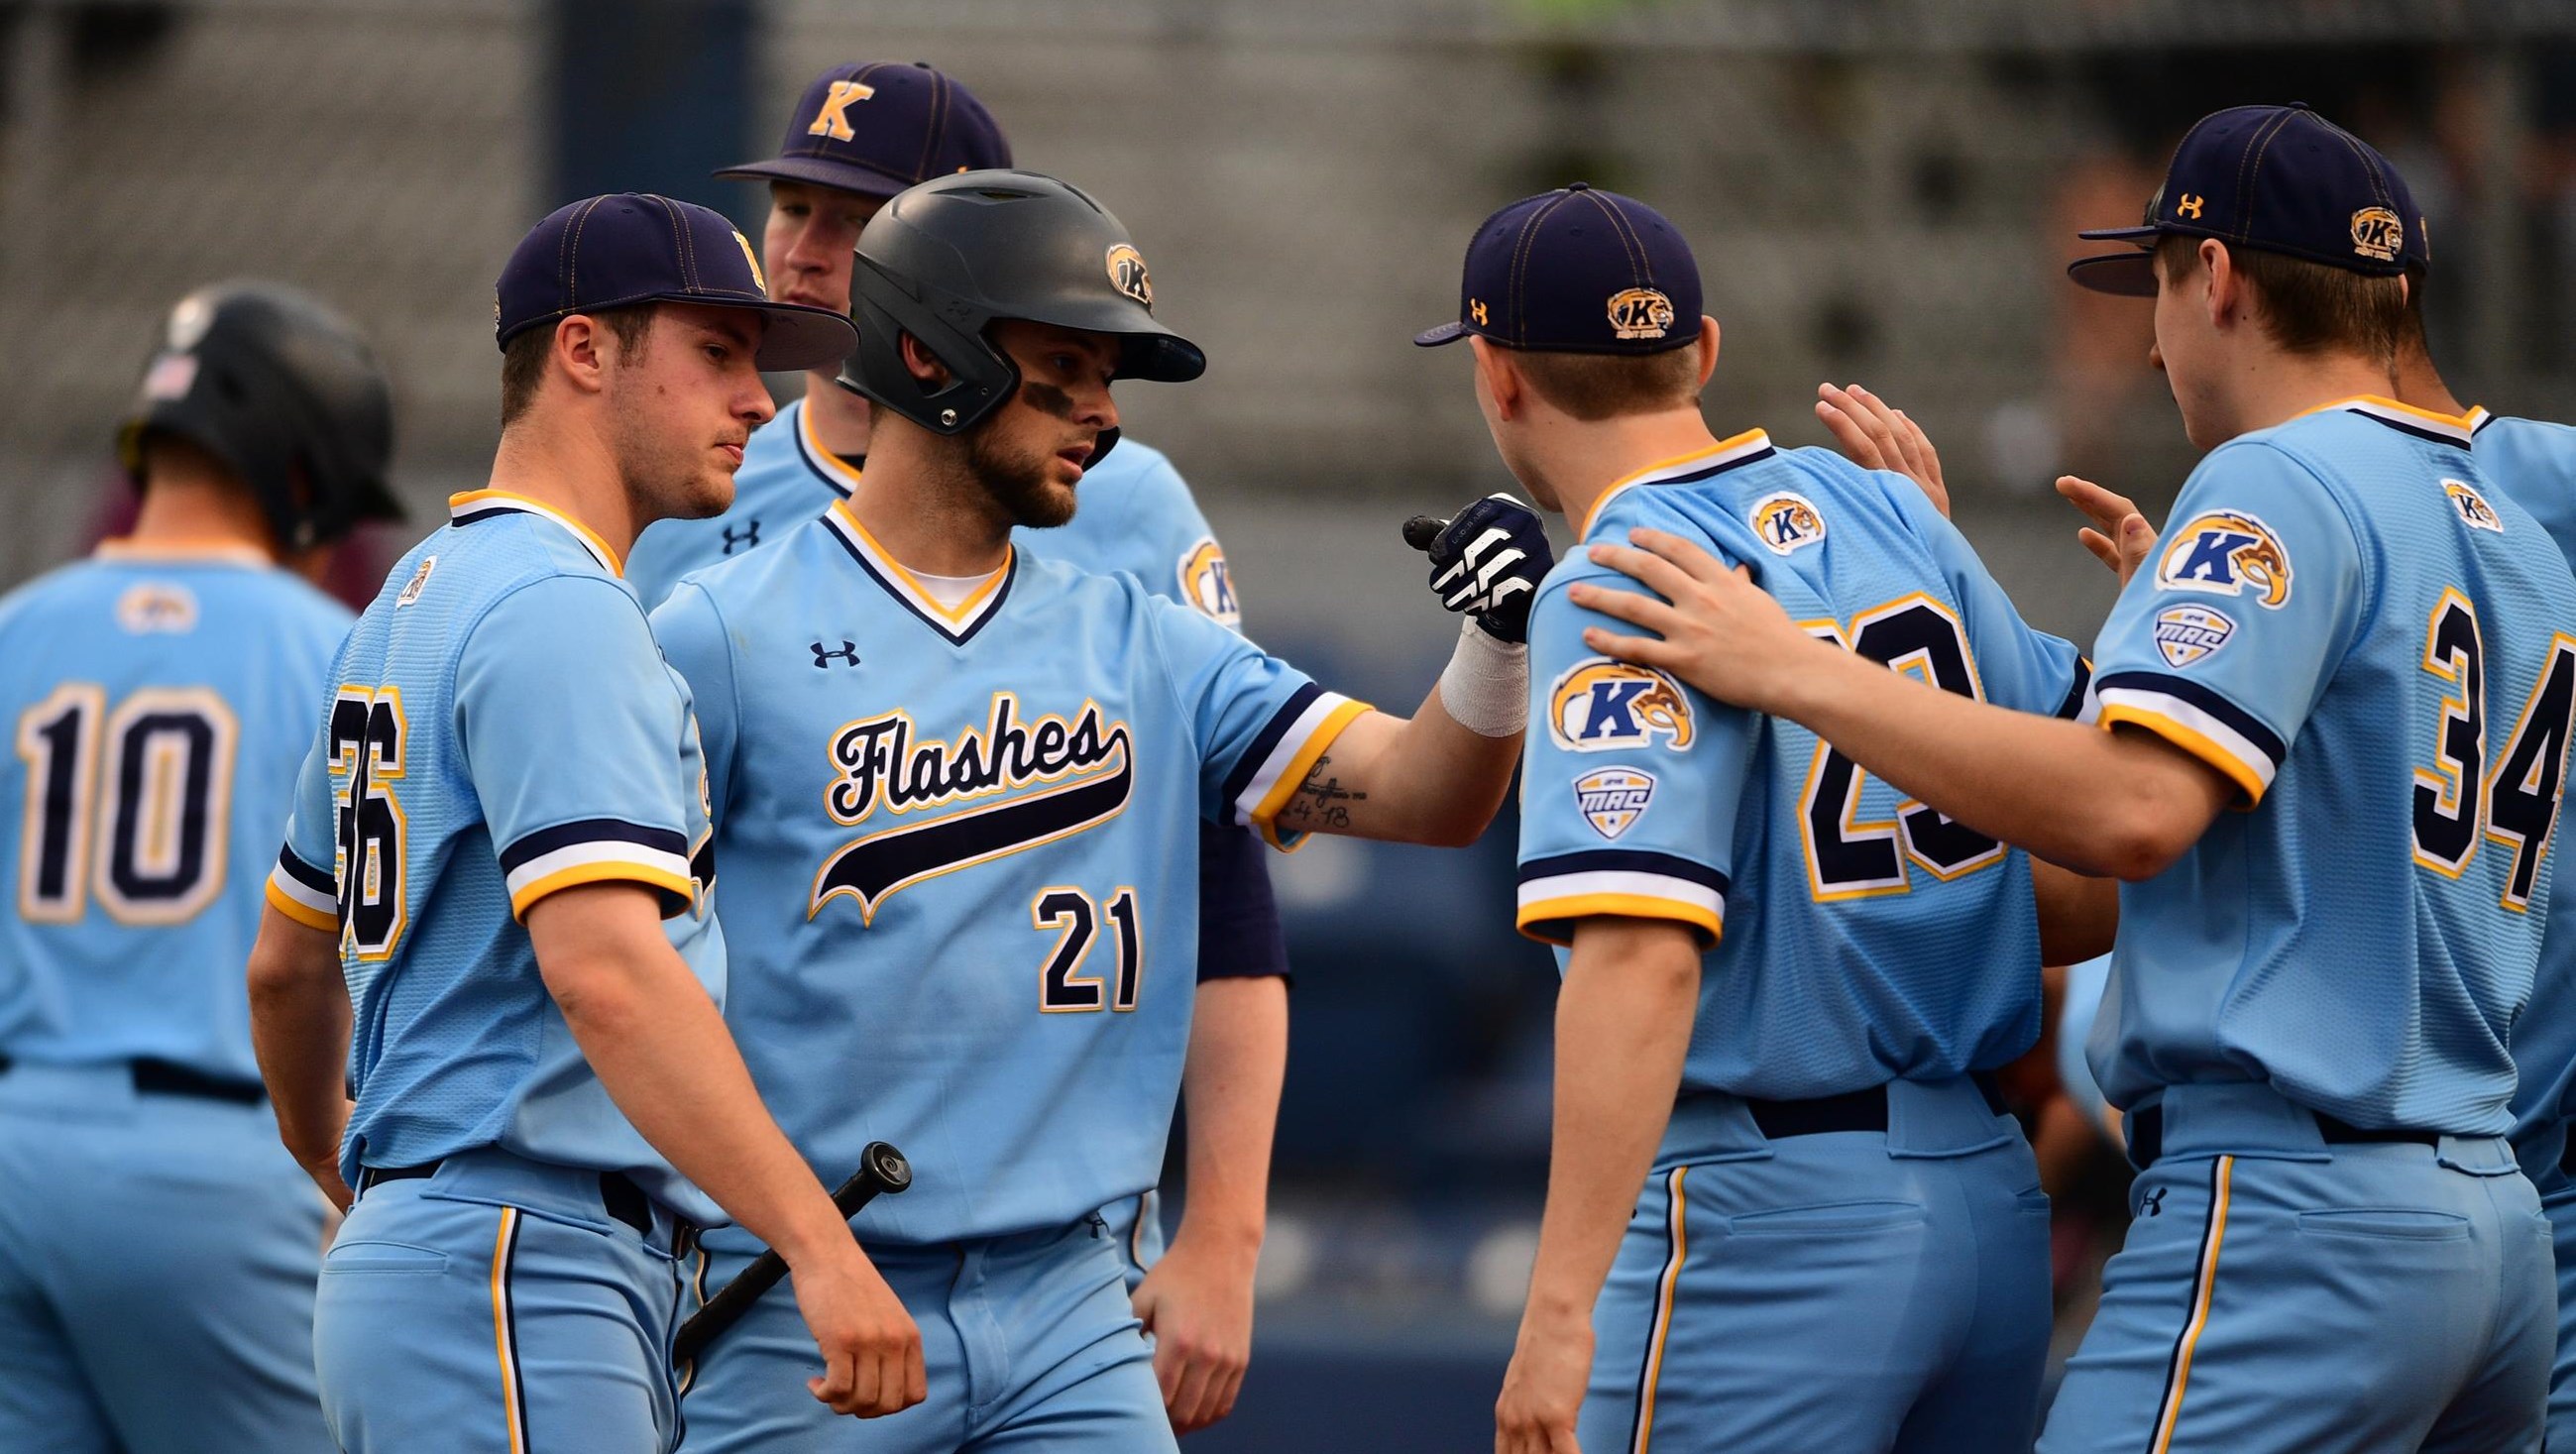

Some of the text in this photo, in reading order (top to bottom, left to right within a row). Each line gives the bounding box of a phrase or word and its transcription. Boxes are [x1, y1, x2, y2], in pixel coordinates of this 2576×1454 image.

[808, 80, 875, 143] K
[1626, 299, 1657, 326] K
[1771, 506, 1802, 544] K
[2174, 531, 2259, 585] K
[2156, 623, 2226, 648] MAC
[1579, 681, 1654, 739] K
[823, 692, 1132, 826] Flashes
[2411, 585, 2576, 913] 34
[18, 683, 239, 926] 10
[1581, 791, 1648, 814] MAC
[1031, 885, 1142, 1014] 21
